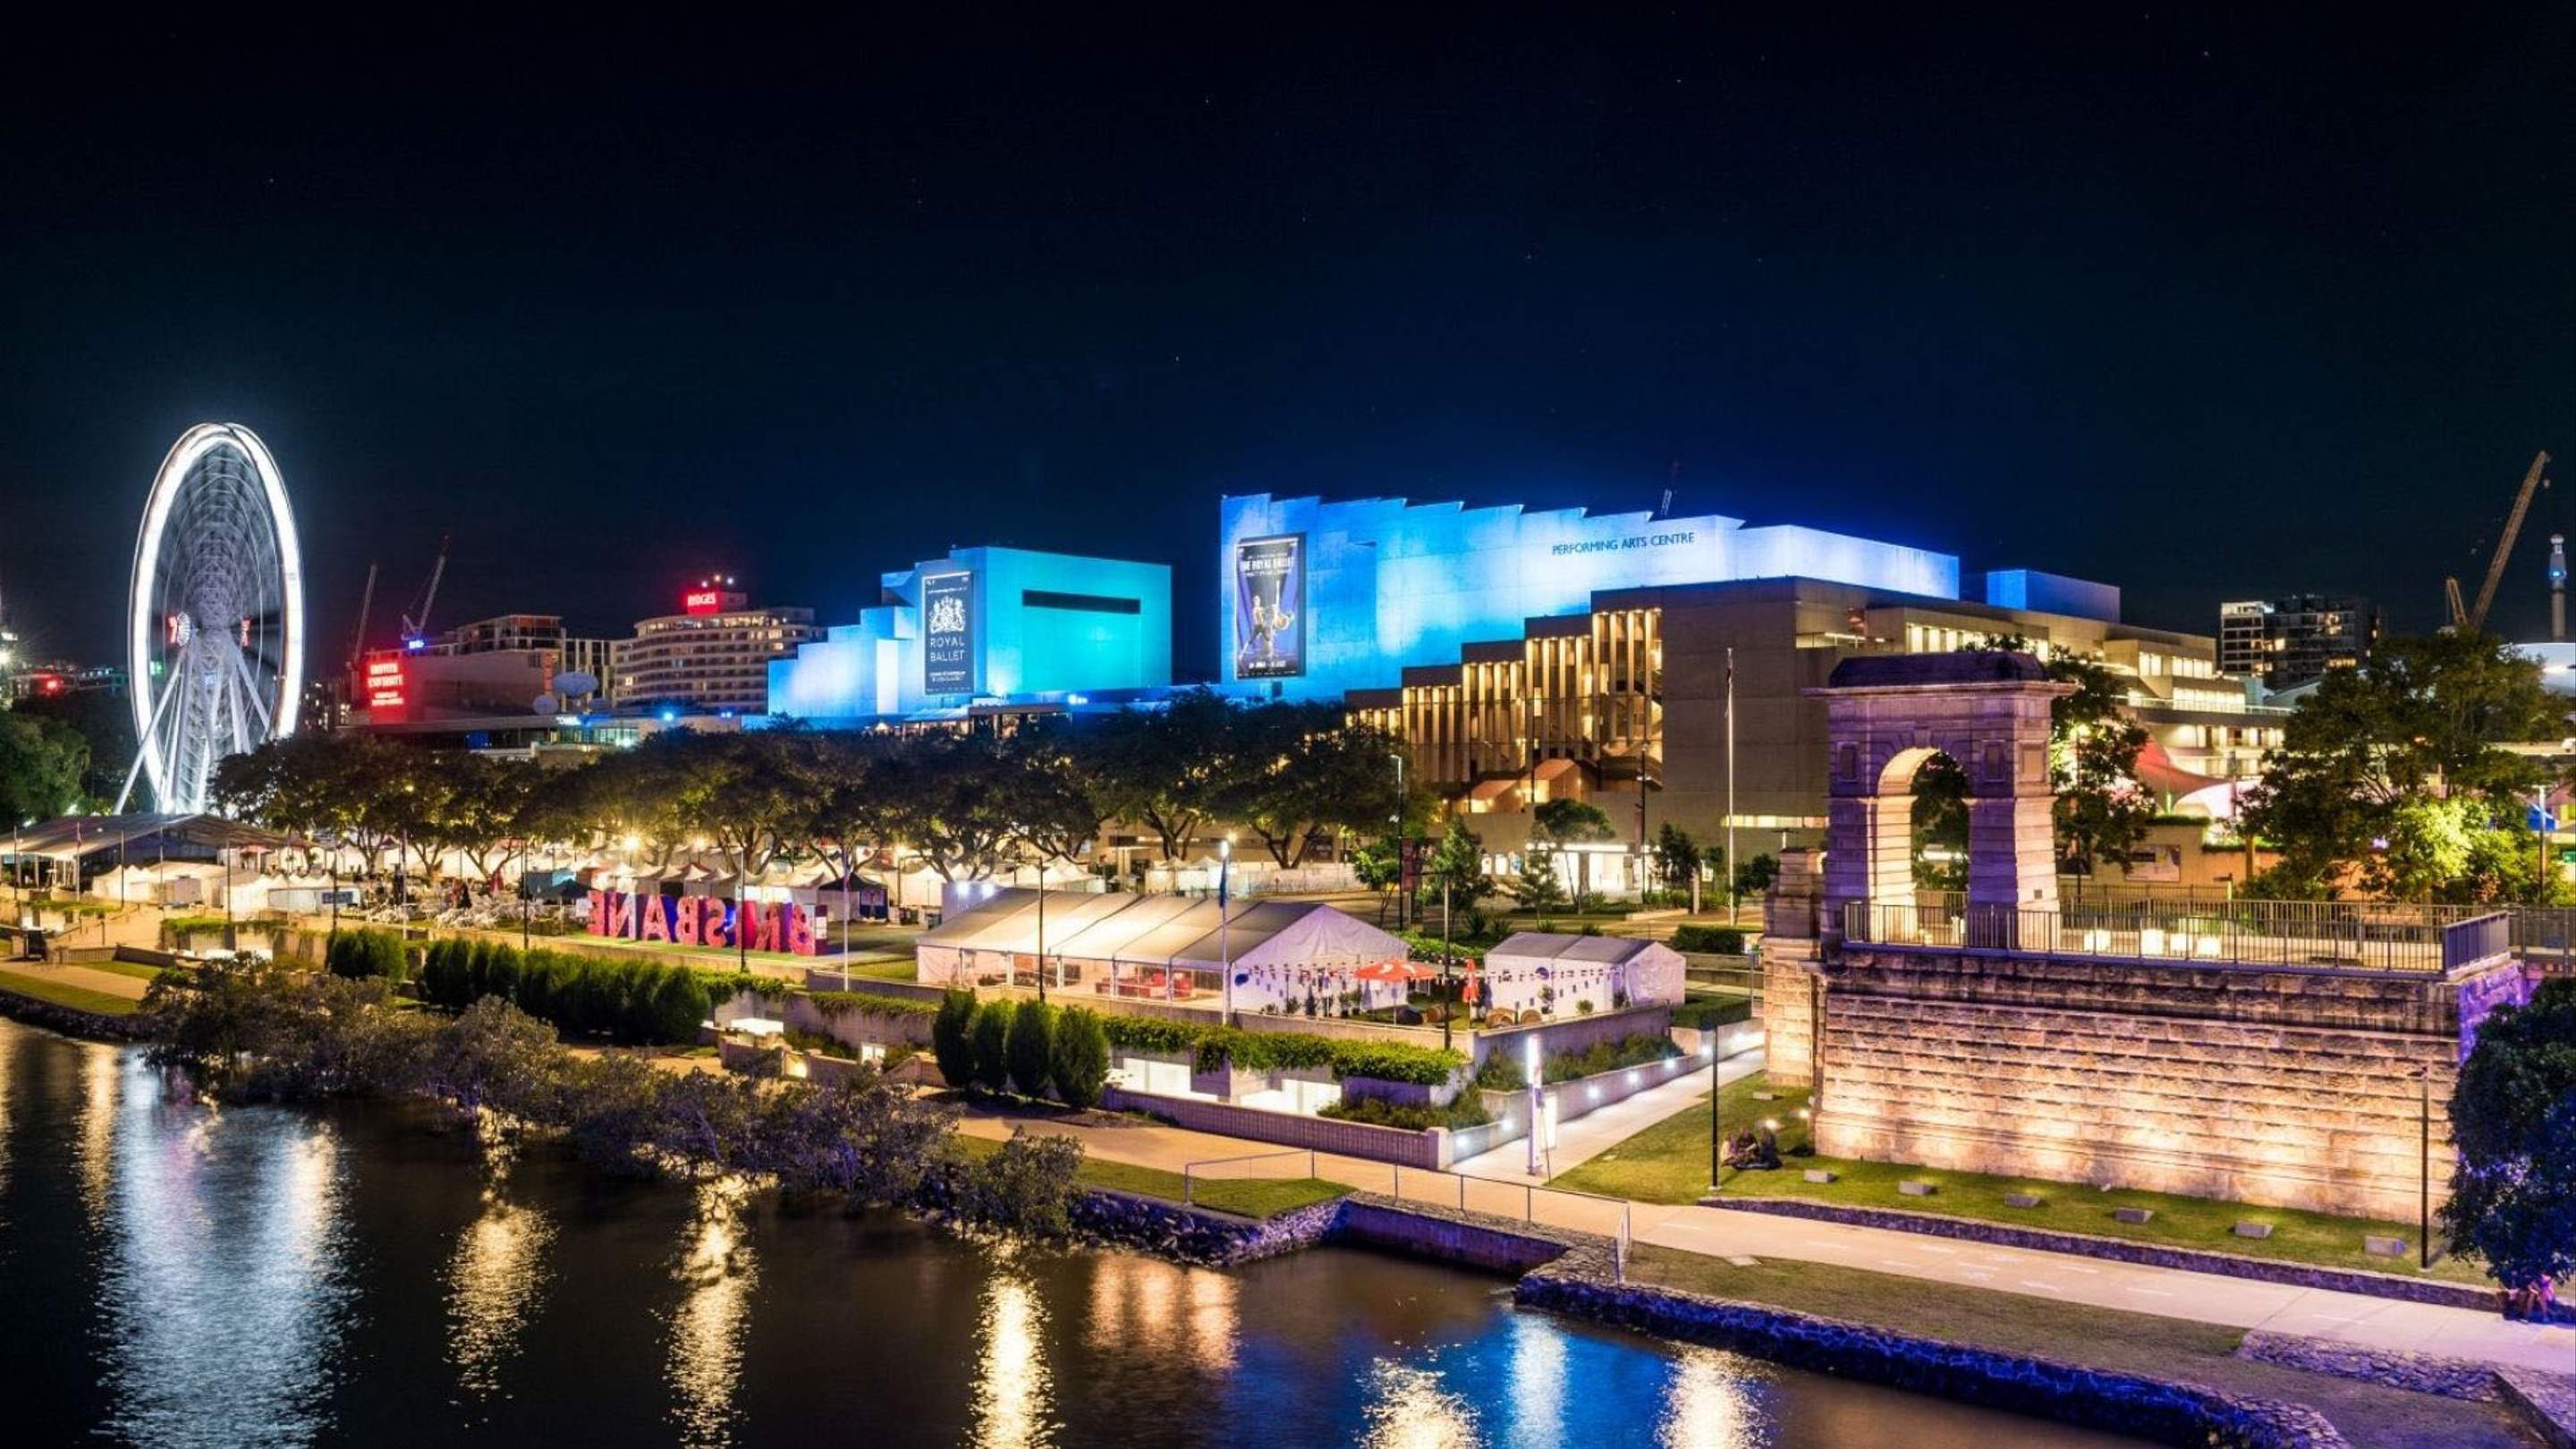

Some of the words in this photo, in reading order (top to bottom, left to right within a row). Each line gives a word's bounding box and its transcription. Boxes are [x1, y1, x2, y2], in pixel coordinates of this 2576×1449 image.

[1552, 539, 1618, 555] PERFORMING
[1622, 536, 1647, 549] ARTS
[1650, 531, 1695, 546] CENTRE
[929, 635, 966, 648] ROYAL
[929, 649, 967, 663] BALLET
